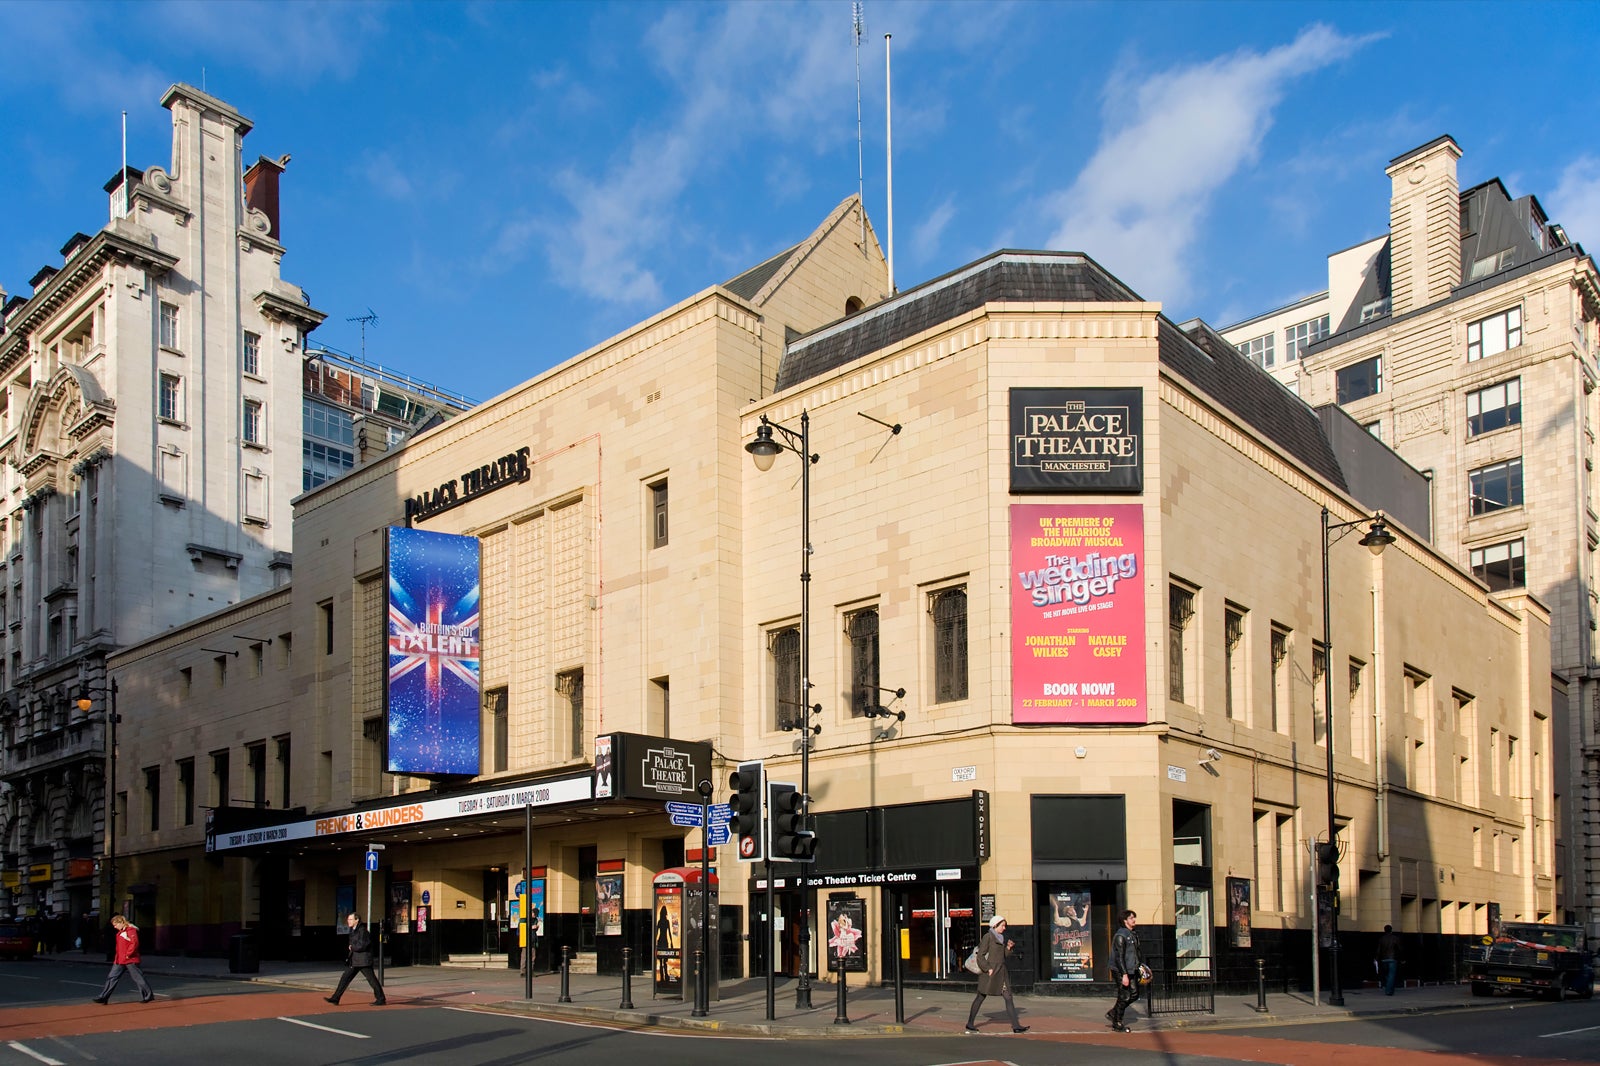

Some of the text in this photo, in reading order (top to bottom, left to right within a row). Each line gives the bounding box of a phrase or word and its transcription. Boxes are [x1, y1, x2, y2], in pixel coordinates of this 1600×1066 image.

[1030, 414, 1123, 435] PALACE
[1018, 437, 1134, 457] THEATRE
[404, 446, 530, 528] PALACE THEATRE
[1040, 518, 1114, 527] UK PREMIERE OF
[1043, 528, 1110, 536] THE HILARIOUS
[1031, 538, 1124, 546] BROADWAY MUSICAL
[1045, 555, 1070, 567] The
[1018, 552, 1137, 590] wedding
[1032, 574, 1120, 607] singer
[1043, 611, 1052, 619] THE
[1062, 606, 1077, 616] MOVIE
[1078, 604, 1088, 614] LIVE
[420, 622, 474, 637] BRITAIN'S GOT
[1025, 636, 1076, 646] JONATHAN
[1088, 636, 1126, 645] NATALIE
[1033, 648, 1068, 657] WILKES
[1093, 647, 1122, 657] CASEY
[1044, 683, 1115, 695] BOOK NOW!
[1023, 699, 1032, 707] 22
[1035, 699, 1072, 707] FEBRUARY
[1117, 698, 1137, 706] 2008
[654, 756, 683, 771] PALACE
[651, 768, 687, 783] THEATRE
[459, 799, 478, 813] TUESDAY
[487, 794, 510, 809] SATURDAY
[512, 794, 515, 805] 8
[516, 790, 534, 804] MARCH
[536, 789, 549, 802] 2008
[315, 804, 424, 835] FRENCH & SAUNDERS
[797, 872, 917, 886] Place Theatre Ticket Centre
